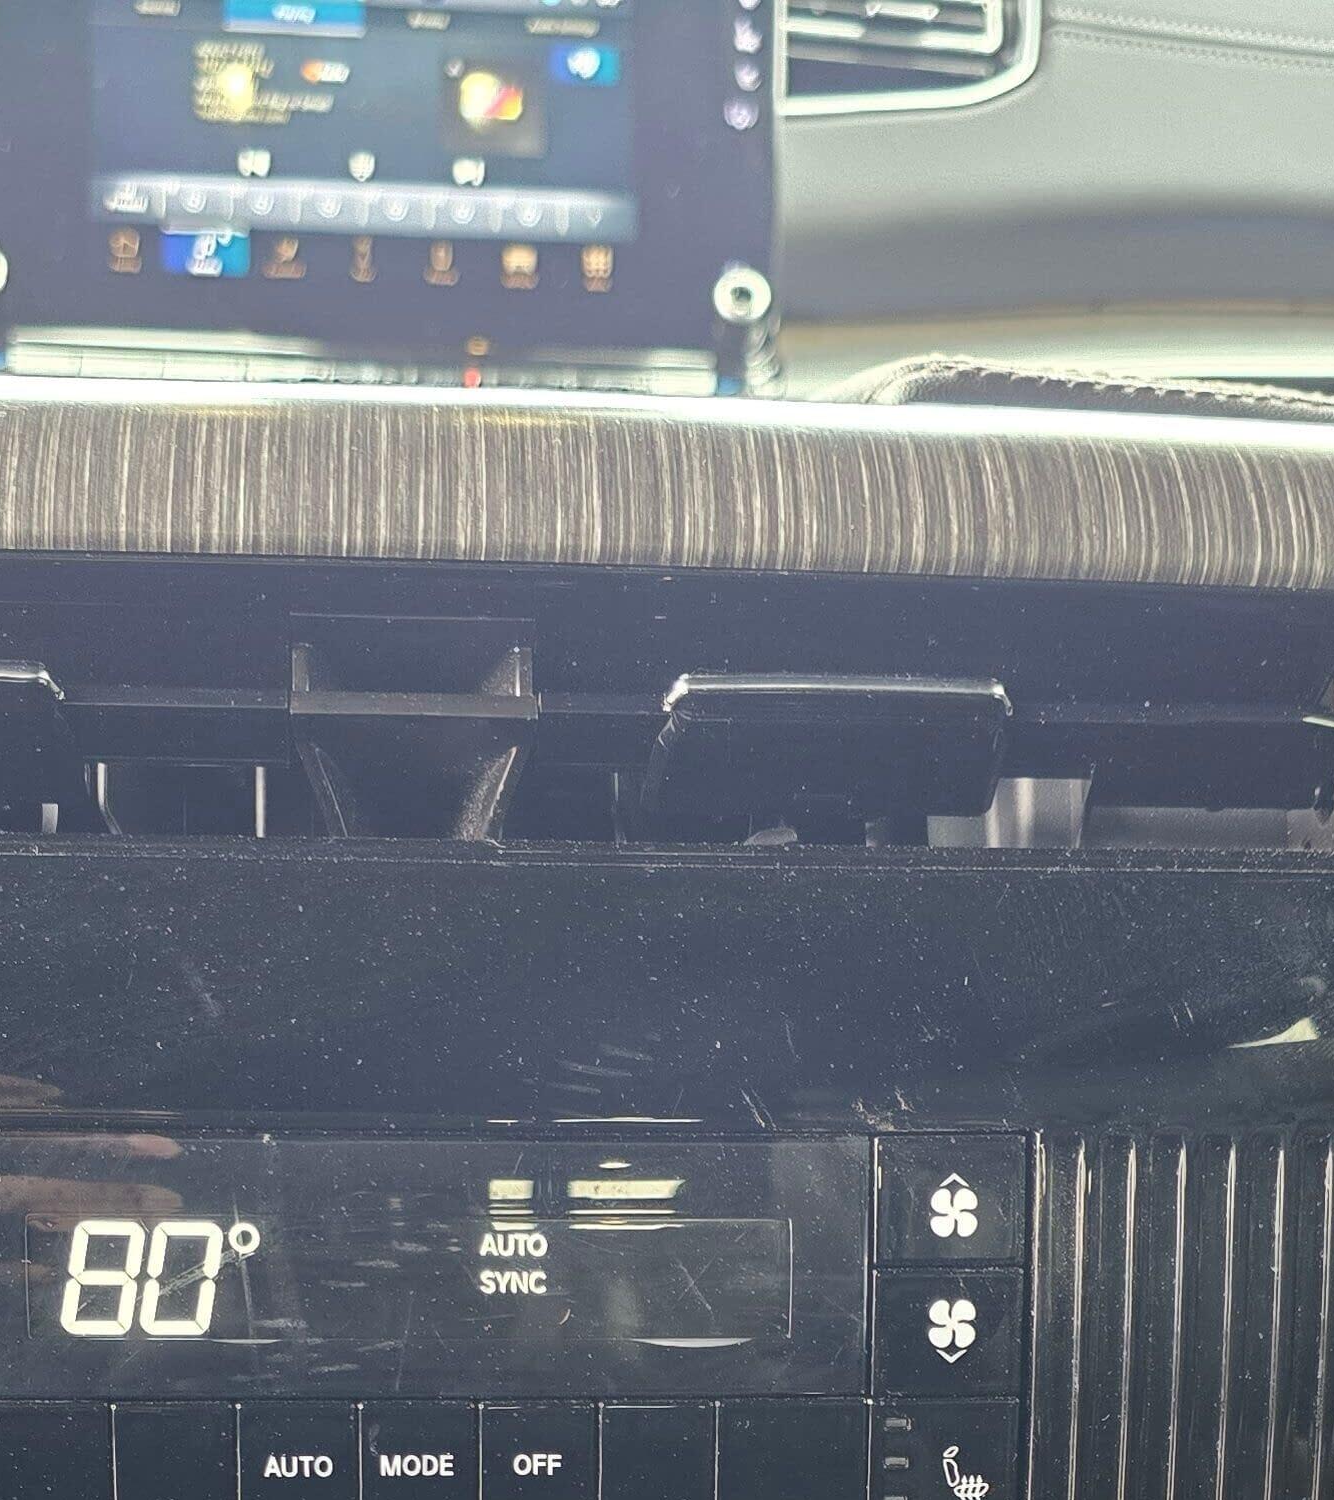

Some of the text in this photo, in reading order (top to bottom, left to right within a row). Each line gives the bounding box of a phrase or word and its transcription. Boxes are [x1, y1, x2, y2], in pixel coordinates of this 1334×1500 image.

[478, 1232, 548, 1259] AUTO
[478, 1269, 548, 1296] SYNC
[263, 1454, 334, 1479] AUTO
[379, 1453, 455, 1478] MODE
[512, 1453, 563, 1477] OFF
